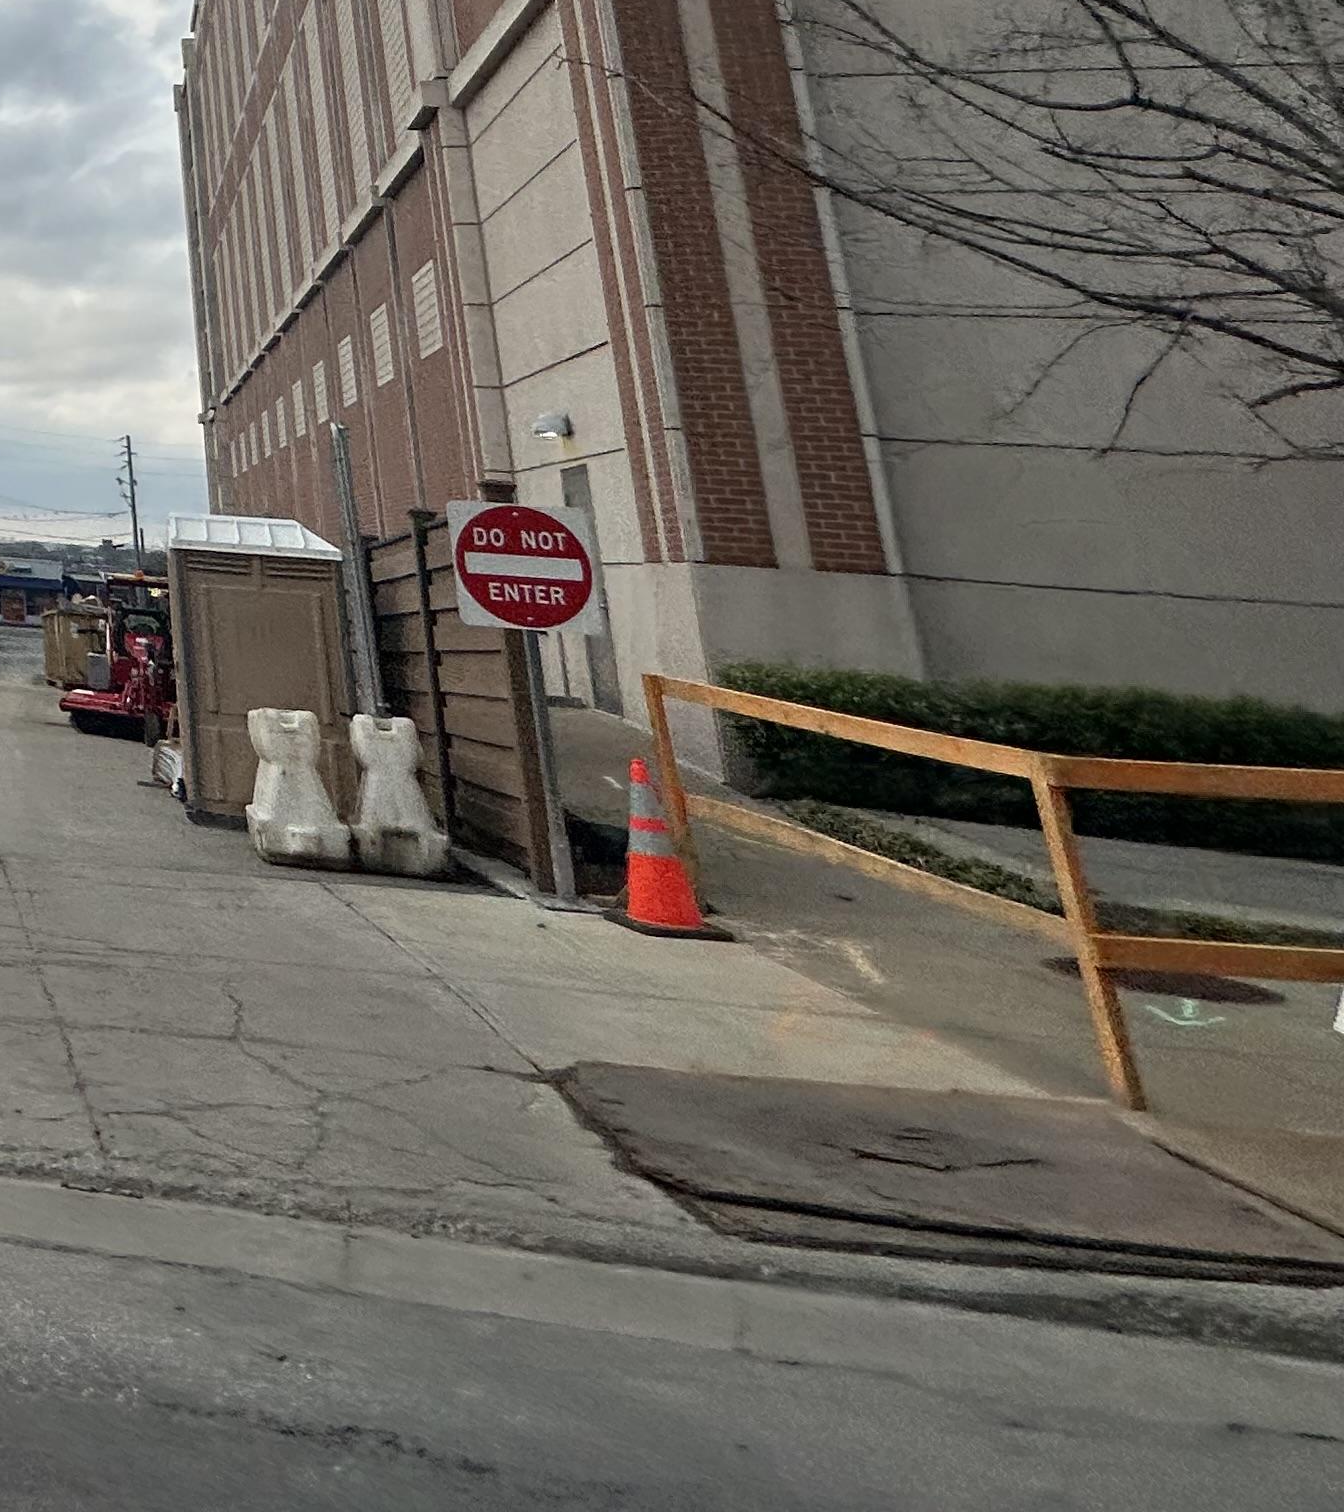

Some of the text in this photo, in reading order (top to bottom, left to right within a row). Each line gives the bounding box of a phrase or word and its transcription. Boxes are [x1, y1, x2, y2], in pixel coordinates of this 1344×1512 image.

[472, 527, 567, 551] DO NOT
[488, 582, 567, 605] ENTER
